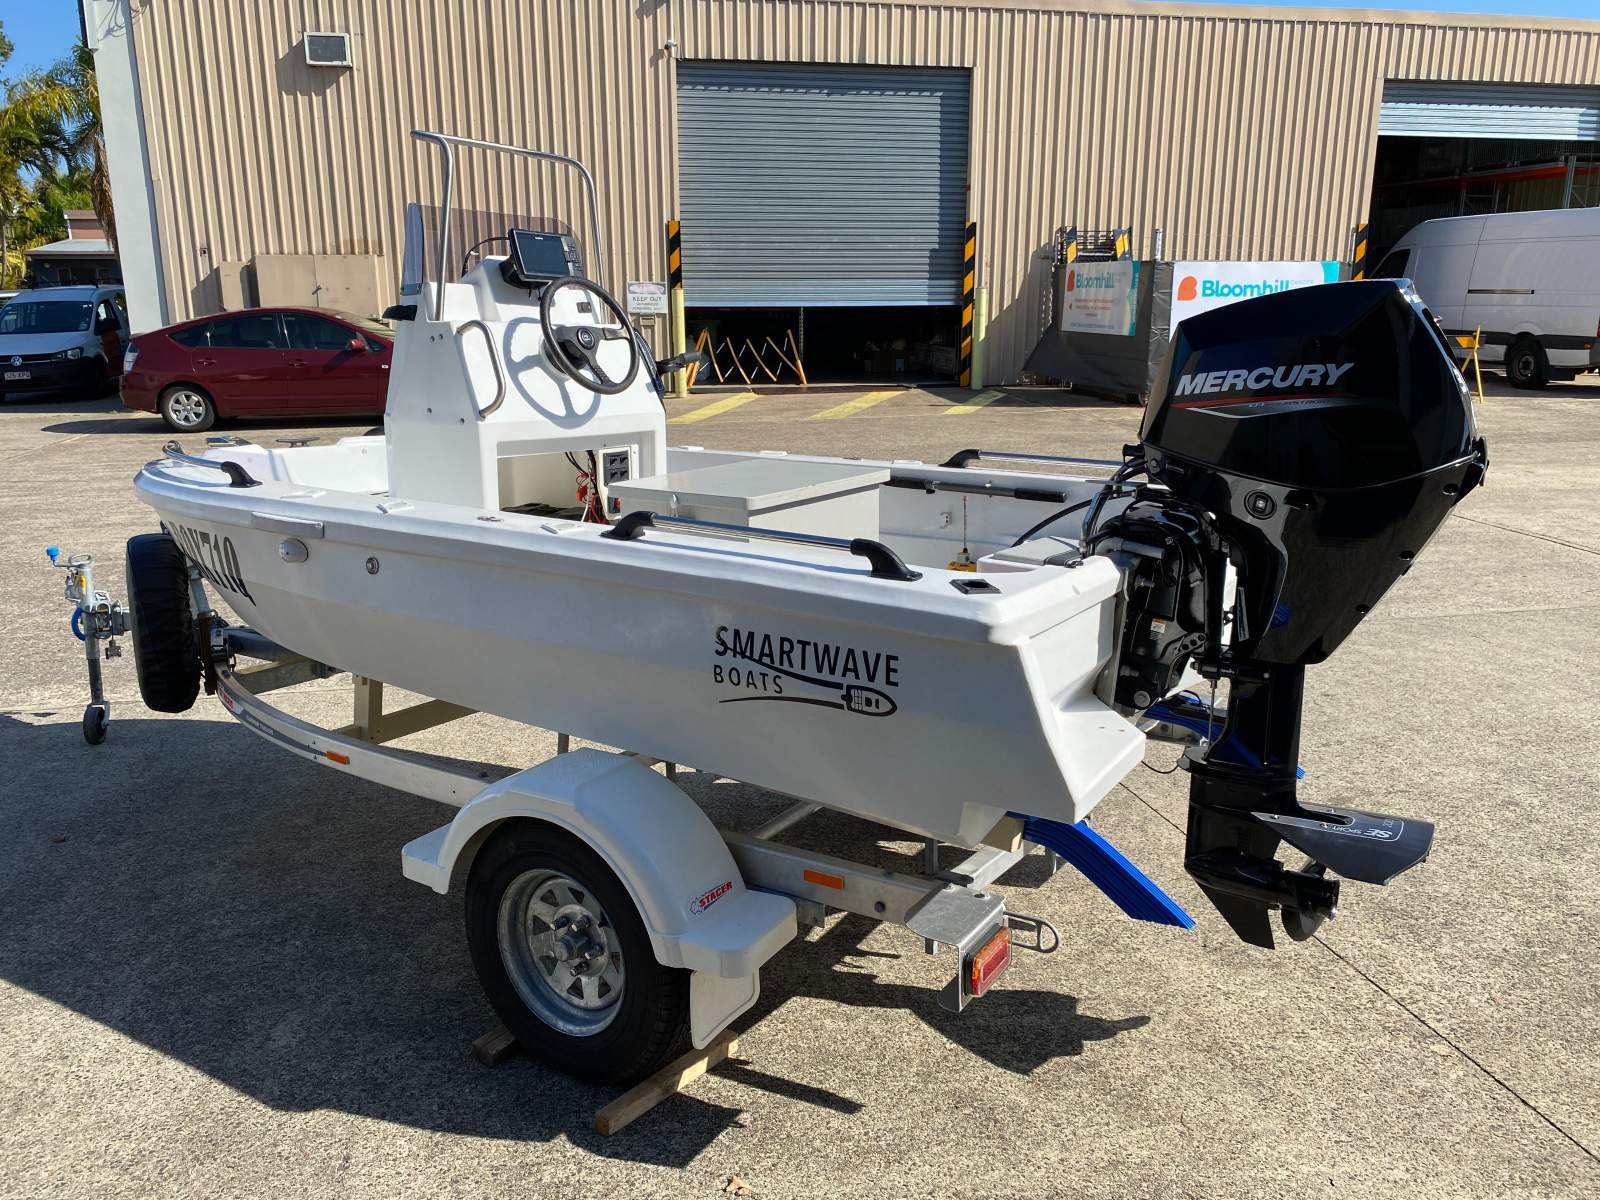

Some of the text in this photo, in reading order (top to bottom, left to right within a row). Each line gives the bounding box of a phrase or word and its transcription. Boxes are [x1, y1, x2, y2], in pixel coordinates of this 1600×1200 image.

[1076, 272, 1114, 288] Bloomhill
[1201, 279, 1290, 297] Bloomhill
[1174, 362, 1355, 396] MERCURY
[714, 625, 899, 687] SMARTWAVE
[713, 664, 783, 694] BOATS
[698, 881, 733, 908] STACER
